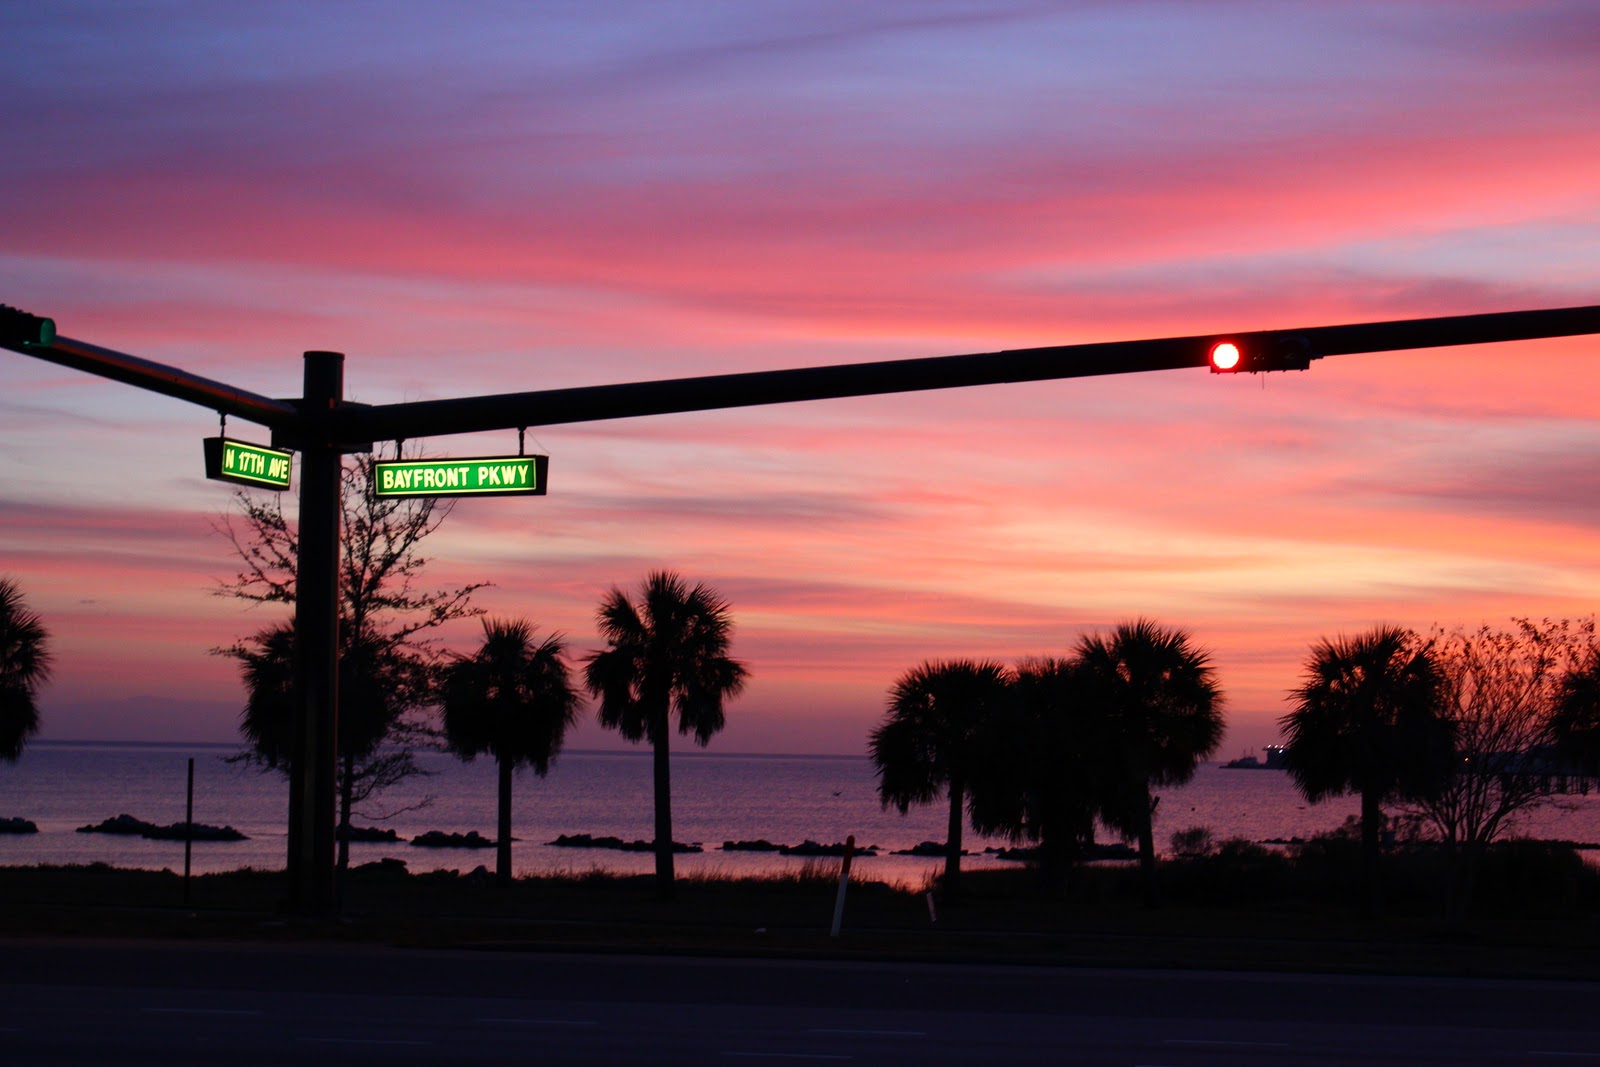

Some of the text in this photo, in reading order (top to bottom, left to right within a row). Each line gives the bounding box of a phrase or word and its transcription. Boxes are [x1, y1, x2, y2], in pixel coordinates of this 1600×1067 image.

[225, 448, 289, 479] N 17TH AVE
[383, 464, 529, 489] BAYFRONT PKWY
